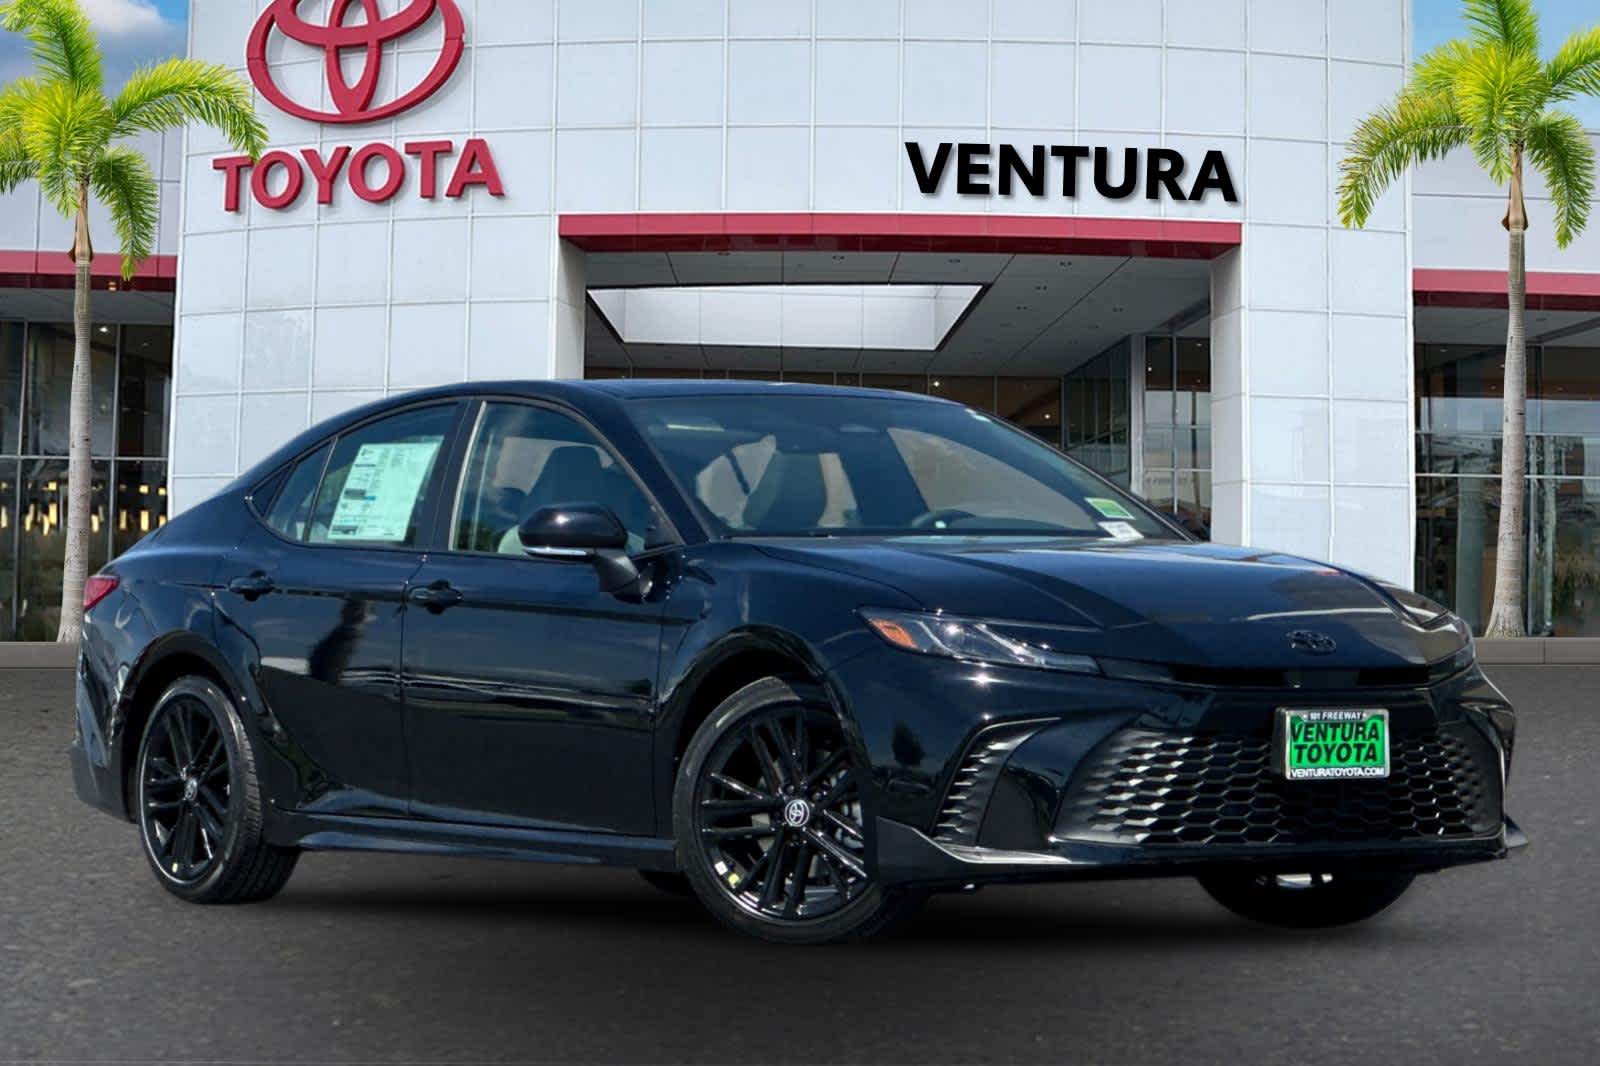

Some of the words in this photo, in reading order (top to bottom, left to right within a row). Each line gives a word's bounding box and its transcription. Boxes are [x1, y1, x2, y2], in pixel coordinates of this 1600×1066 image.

[213, 138, 505, 212] TOYOTA
[904, 141, 1239, 203] VENTURA
[1322, 711, 1362, 720] FREEWAY
[1290, 721, 1379, 742] VENTURA
[1294, 743, 1378, 763] TOYOTA
[1291, 767, 1385, 778] VENTURATOYOTA.COM
